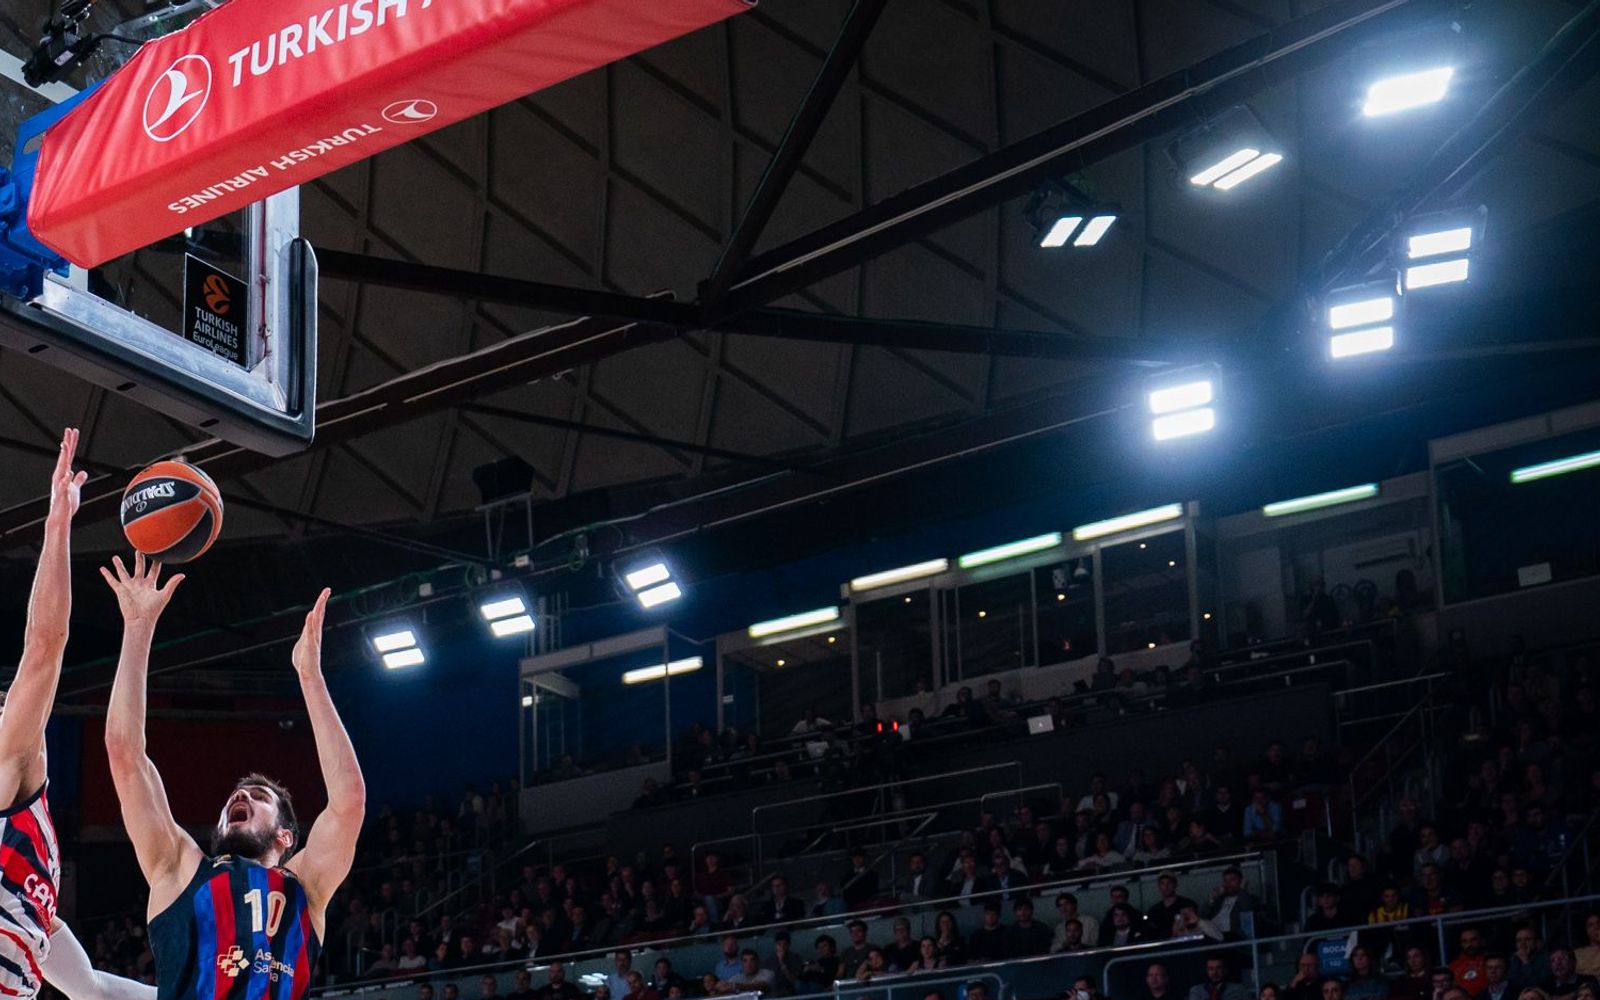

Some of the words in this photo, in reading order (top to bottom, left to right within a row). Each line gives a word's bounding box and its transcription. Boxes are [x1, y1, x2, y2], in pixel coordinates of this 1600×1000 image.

[228, 0, 408, 88] TURKISH
[270, 123, 383, 171] TURKISH
[168, 165, 269, 214] AIRLINES
[192, 331, 239, 360] EuroLeague
[194, 319, 238, 349] AIRLINES
[195, 306, 238, 337] TURKISH
[244, 888, 287, 938] 10
